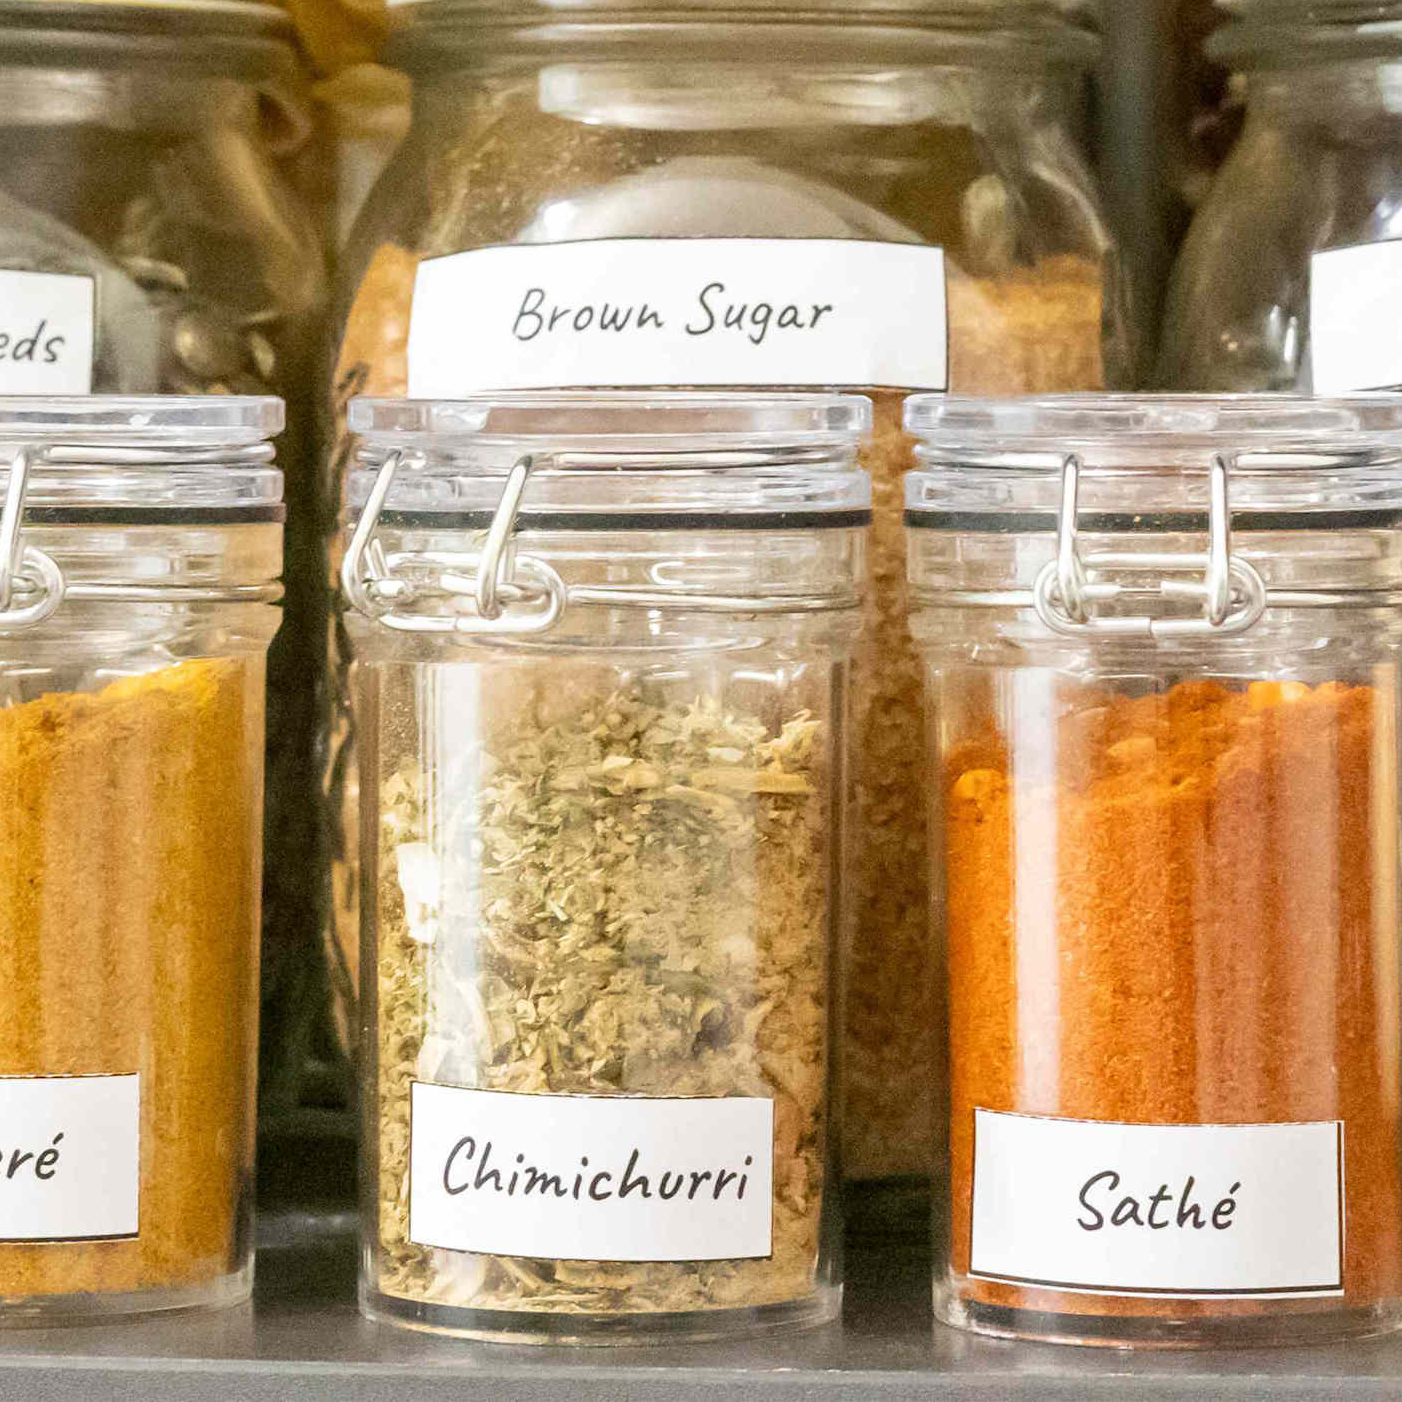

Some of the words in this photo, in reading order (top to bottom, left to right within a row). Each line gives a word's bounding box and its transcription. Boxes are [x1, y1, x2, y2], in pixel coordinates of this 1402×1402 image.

[513, 288, 663, 341] Brown
[686, 283, 832, 345] Sugar
[444, 1137, 752, 1201] Chimichurri
[1078, 1171, 1241, 1231] Sathé
